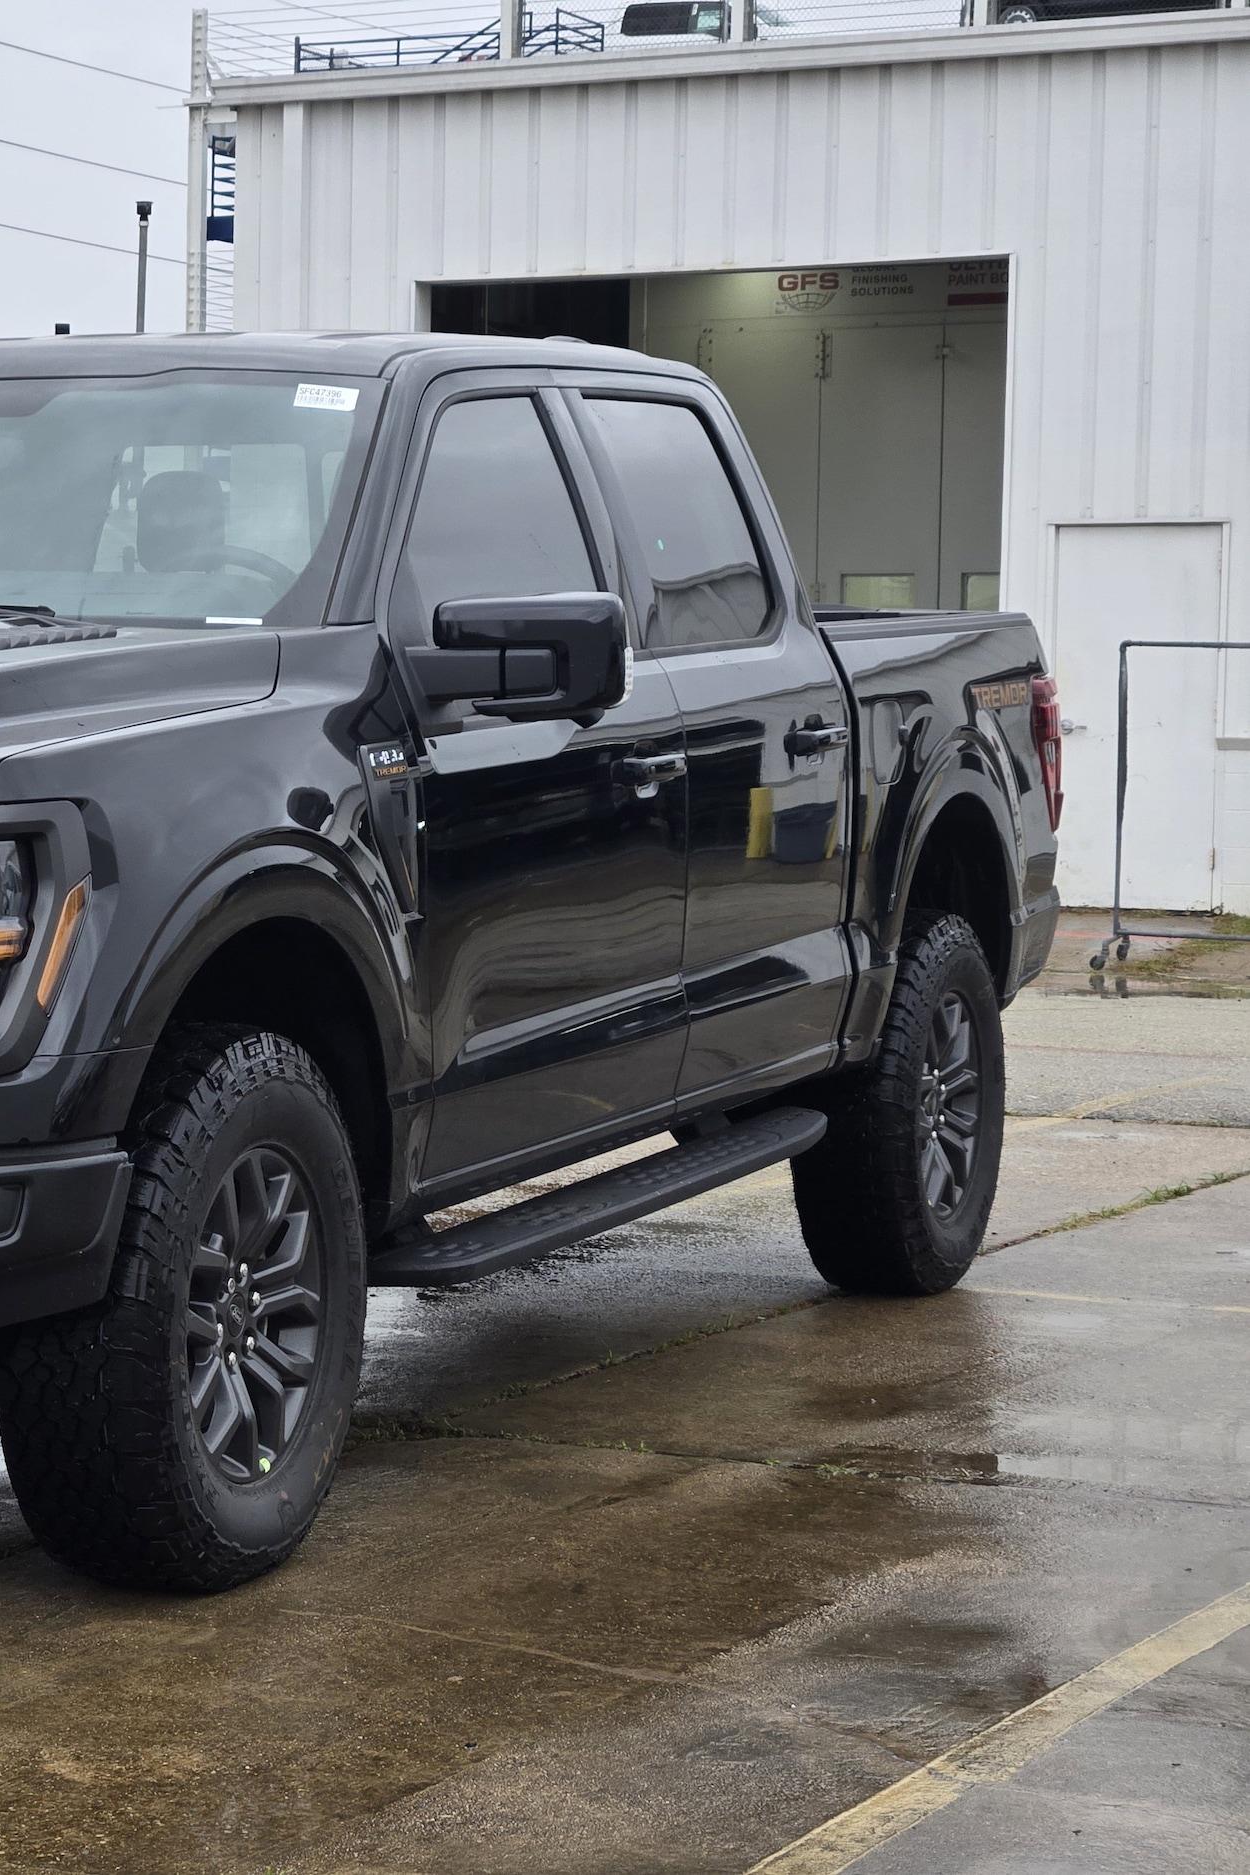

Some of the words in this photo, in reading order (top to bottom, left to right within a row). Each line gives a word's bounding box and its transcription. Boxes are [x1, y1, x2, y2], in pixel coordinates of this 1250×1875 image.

[777, 272, 840, 292] GFS
[851, 273, 908, 284] FINISHING
[948, 273, 987, 286] PAINT
[850, 285, 914, 297] SOLUTIONS
[970, 682, 1029, 709] TREMOR
[375, 765, 407, 777] TREMOR
[331, 1159, 363, 1382] GENERAL
